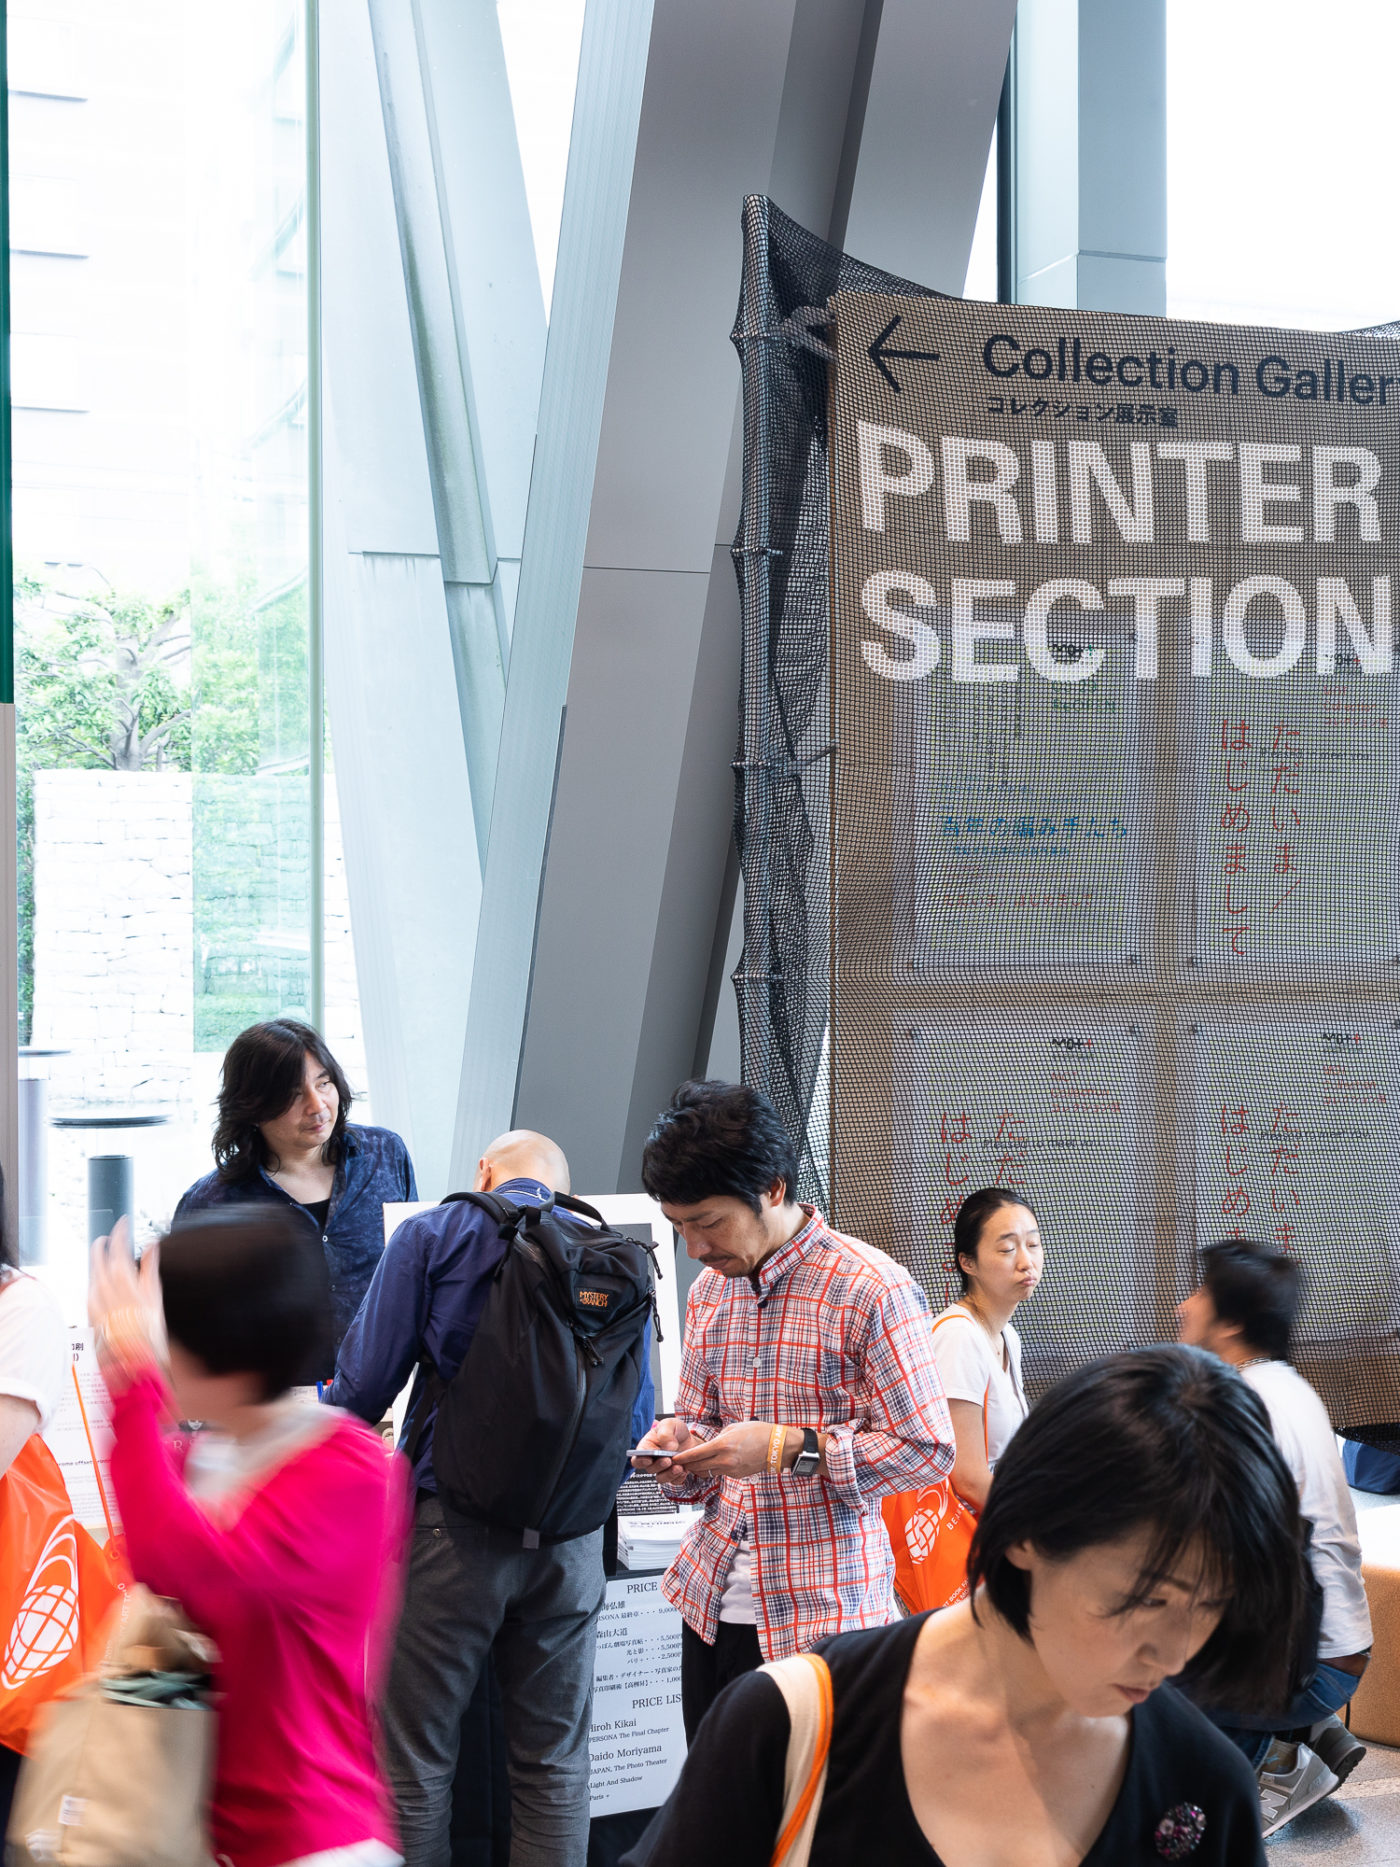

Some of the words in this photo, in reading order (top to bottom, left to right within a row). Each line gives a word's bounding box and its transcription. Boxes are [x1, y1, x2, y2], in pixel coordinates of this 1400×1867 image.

[983, 333, 1240, 396] Collection
[986, 396, 1179, 429] コレクション展示室
[857, 418, 1383, 545] PRINTER
[859, 570, 1394, 683] SECTION
[1220, 718, 1252, 956] はじめまして
[1222, 1104, 1251, 1241] はじめ
[1271, 1101, 1300, 1254] ただいま
[770, 1437, 780, 1464] TOKYO
[627, 1581, 658, 1594] PRICE
[632, 1696, 663, 1709] PRICE
[666, 1694, 682, 1705] LIS
[614, 1718, 637, 1729] Kikai
[647, 1727, 669, 1736] Chapter
[589, 1752, 614, 1762] Daido
[617, 1745, 662, 1759] Moriyama
[614, 1764, 625, 1772] The
[626, 1762, 644, 1770] Photo
[645, 1759, 668, 1767] Theater
[620, 1775, 643, 1784] Shadow
